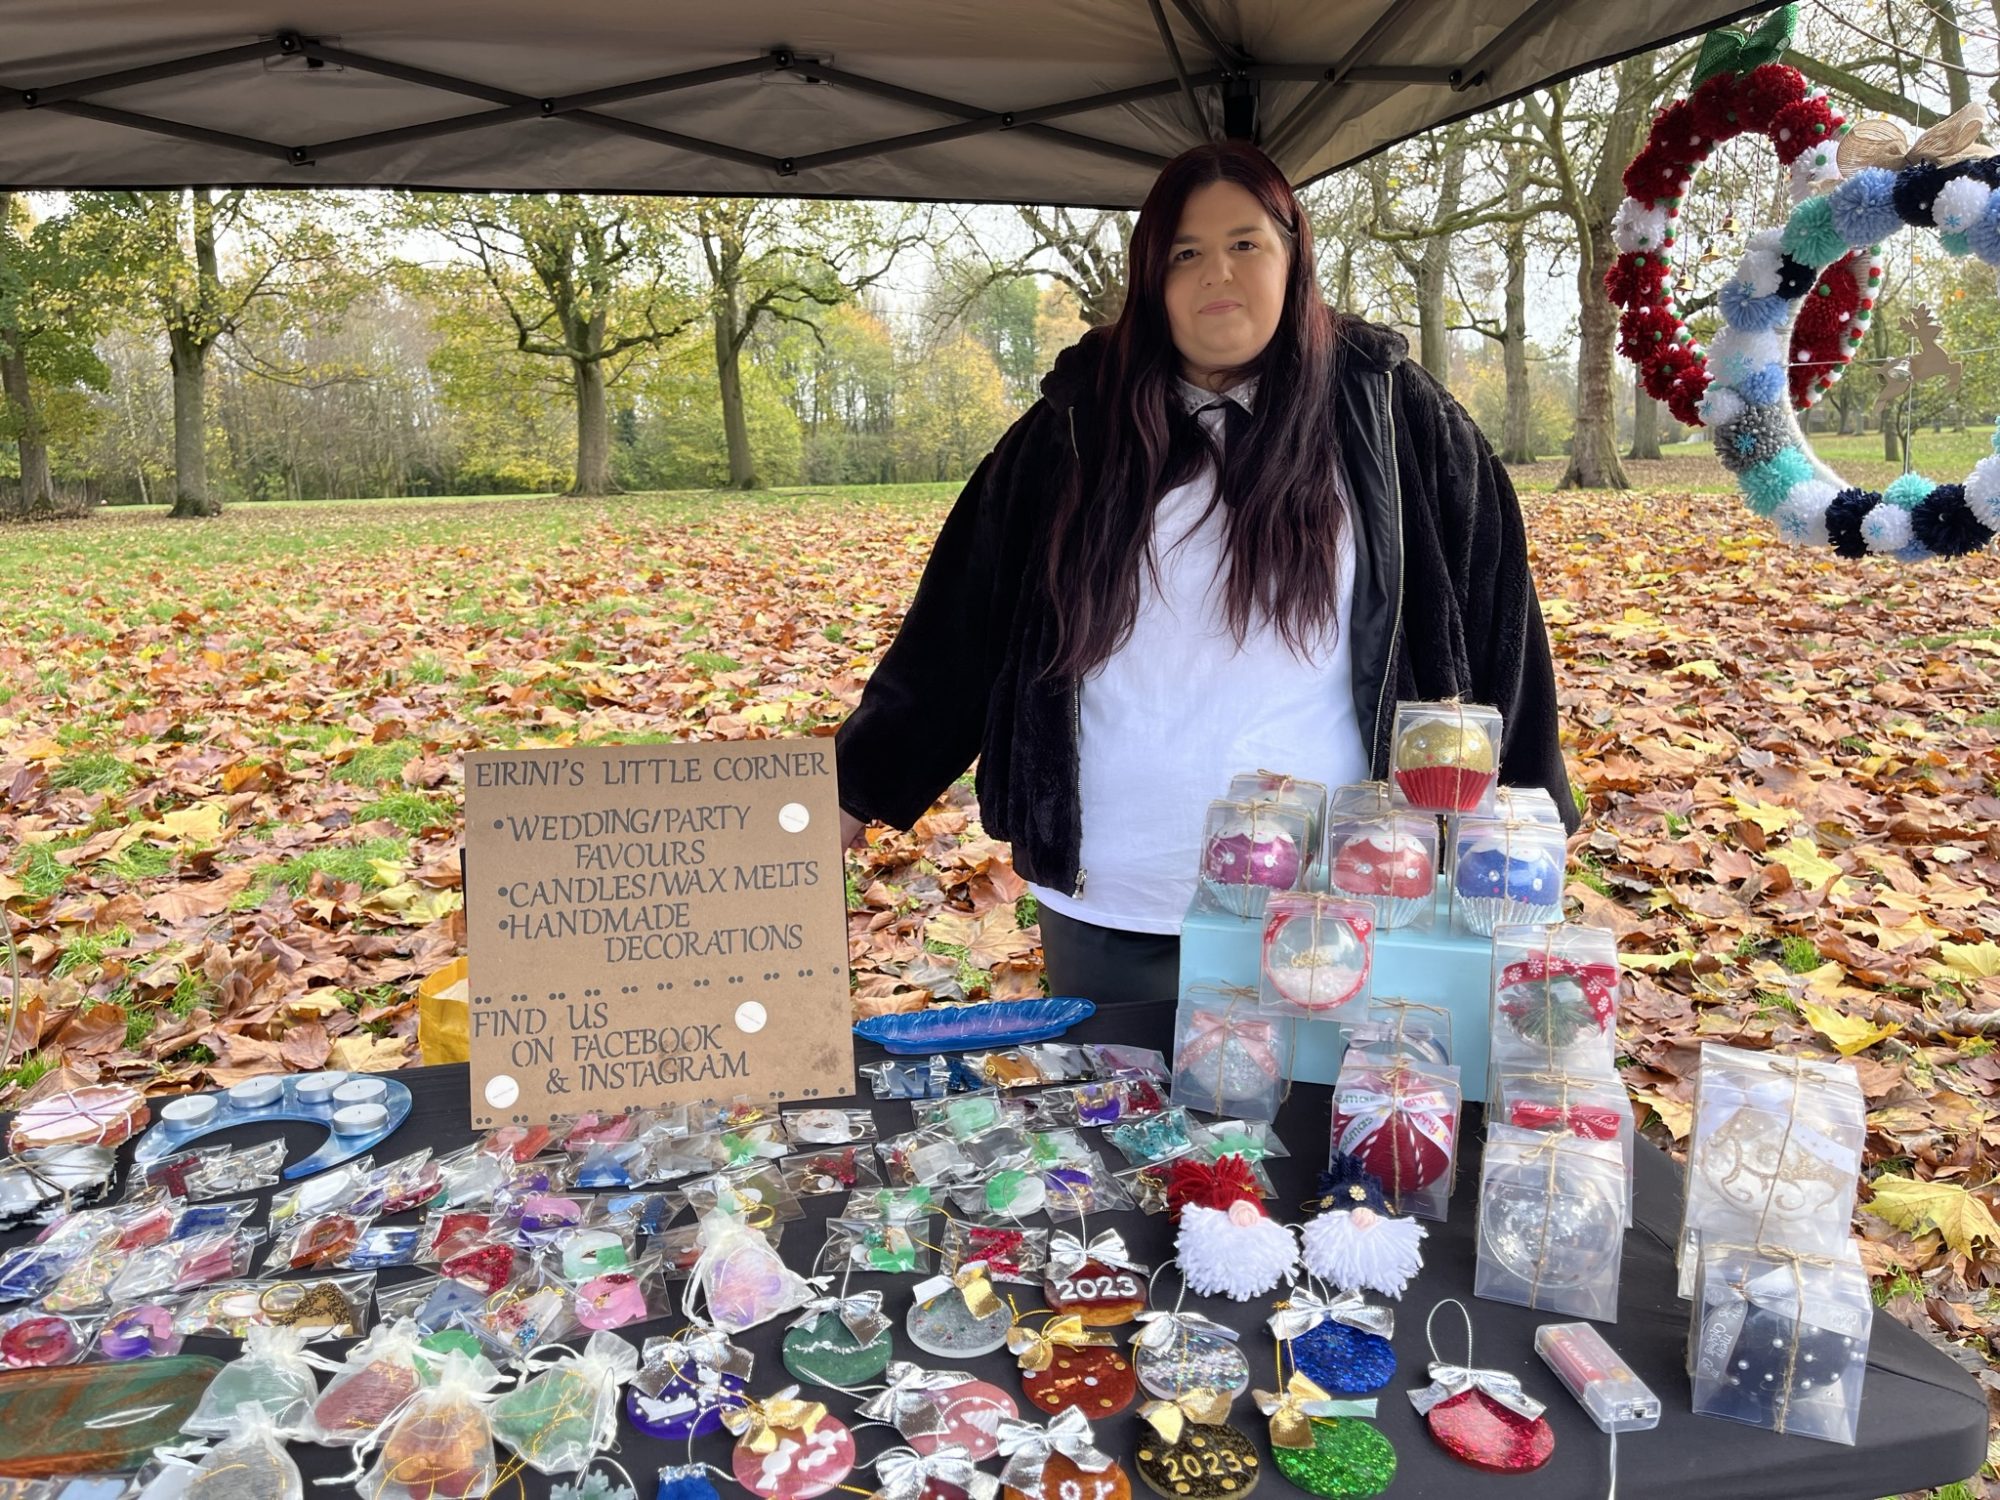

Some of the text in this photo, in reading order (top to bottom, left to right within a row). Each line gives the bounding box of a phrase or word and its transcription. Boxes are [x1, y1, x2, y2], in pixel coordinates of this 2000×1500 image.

[475, 752, 829, 787] EIRINI'S LITTLE CORNER
[506, 805, 751, 841] WEDDING/PARTY
[574, 840, 705, 870] FAVOURS
[509, 861, 818, 908] CANDLES/WAX MELTS
[509, 903, 690, 940] HANDMADE
[604, 924, 802, 963] DECORATIONS
[472, 1002, 608, 1037] FIND US
[512, 1024, 722, 1067] ON FACEBOOK
[546, 1051, 750, 1094] & INSTAGRAM
[1055, 1276, 1138, 1300] 2023
[1162, 1450, 1242, 1482] 2023
